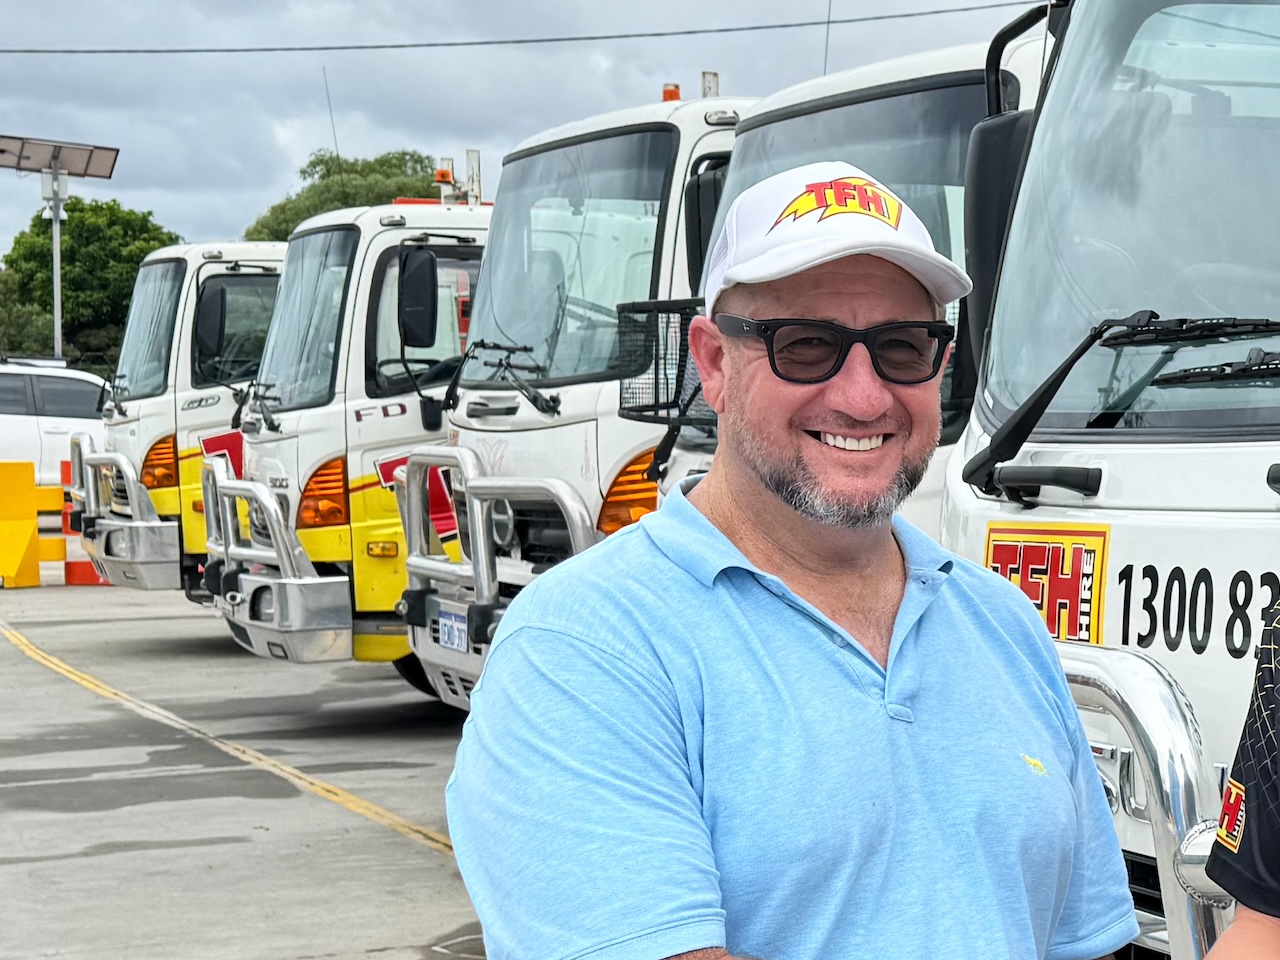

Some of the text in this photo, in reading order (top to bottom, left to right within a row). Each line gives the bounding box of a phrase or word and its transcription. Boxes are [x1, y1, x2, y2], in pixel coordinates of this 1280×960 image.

[805, 180, 885, 217] TFH
[354, 402, 407, 423] FD
[1079, 551, 1096, 641] HIRE
[1118, 564, 1214, 655] 1300
